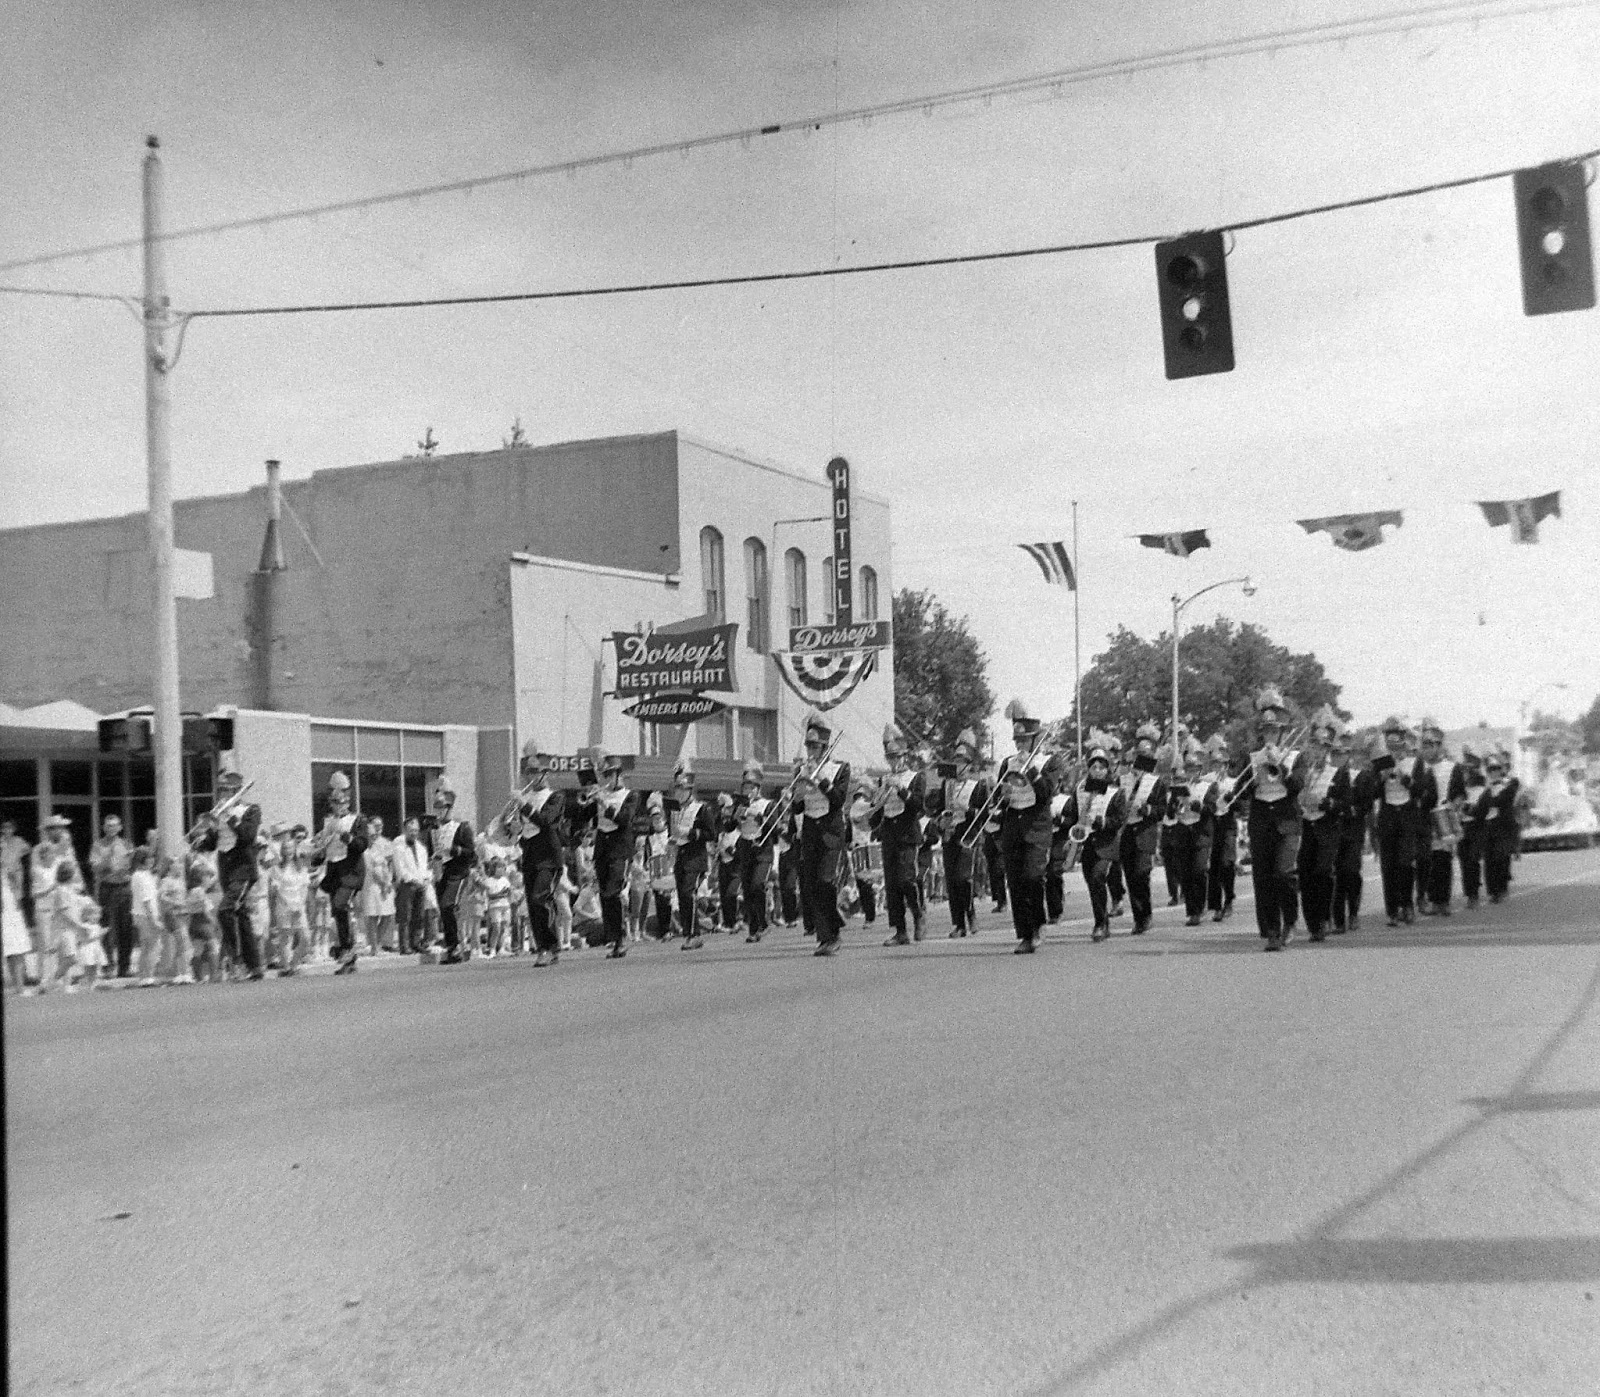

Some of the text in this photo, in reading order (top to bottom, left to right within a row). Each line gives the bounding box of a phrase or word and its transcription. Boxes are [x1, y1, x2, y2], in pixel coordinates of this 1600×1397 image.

[833, 467, 850, 611] HOTEL
[619, 628, 726, 669] Dorsey's
[620, 667, 725, 688] RESTAURANT
[633, 700, 715, 716] EMBERS ROOM
